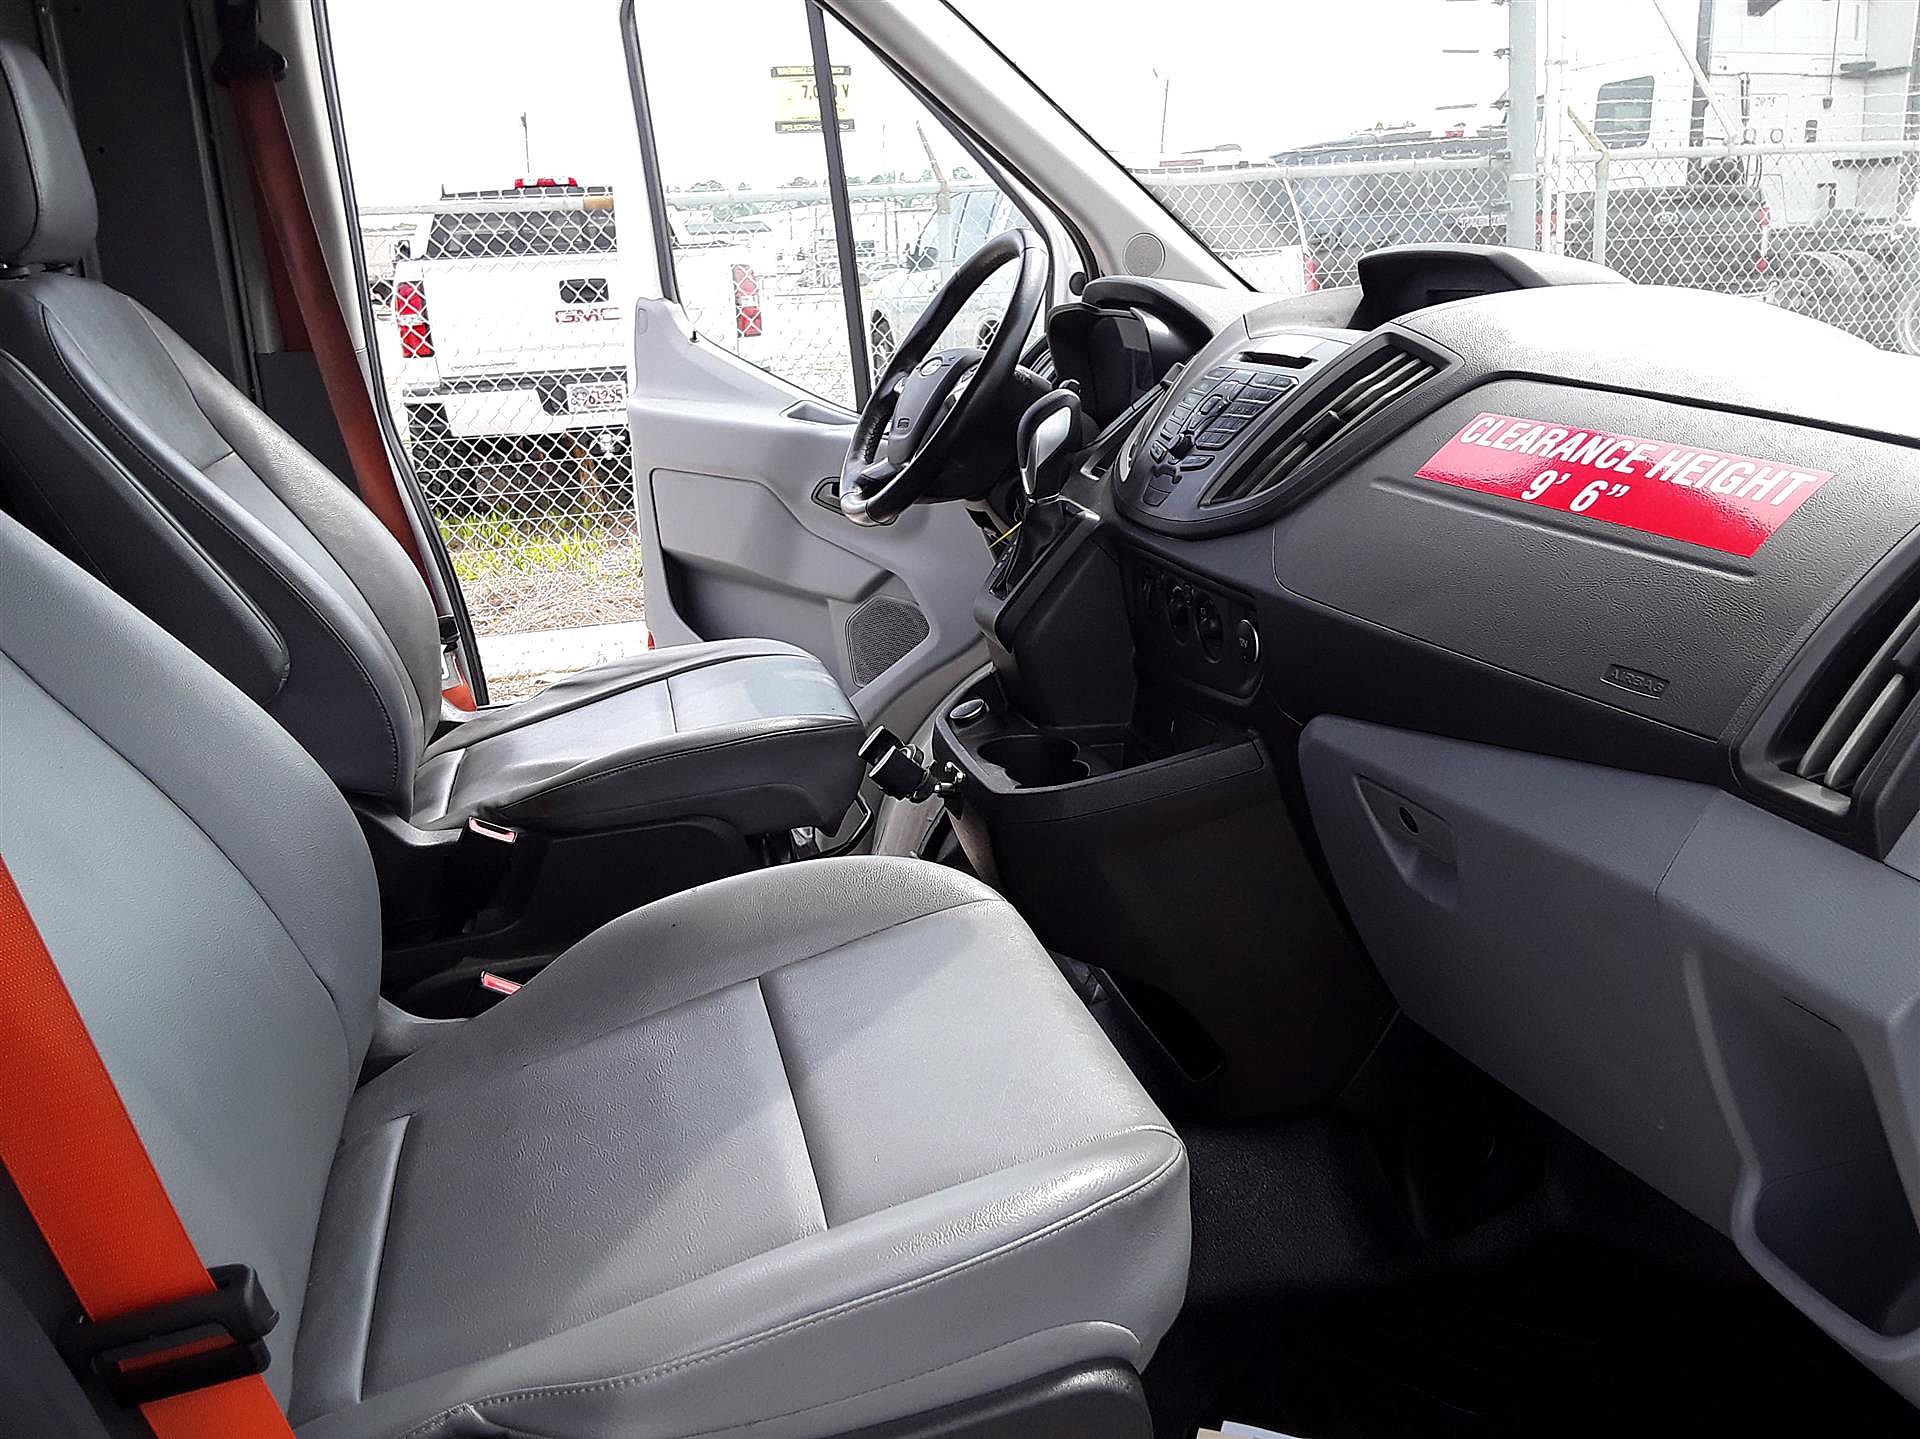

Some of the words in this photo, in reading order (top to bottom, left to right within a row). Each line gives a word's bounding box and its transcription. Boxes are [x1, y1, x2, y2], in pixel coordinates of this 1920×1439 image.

[555, 307, 622, 323] GMC
[1459, 416, 1658, 472] CLEARANCE
[1645, 448, 1819, 507] HEIGHT
